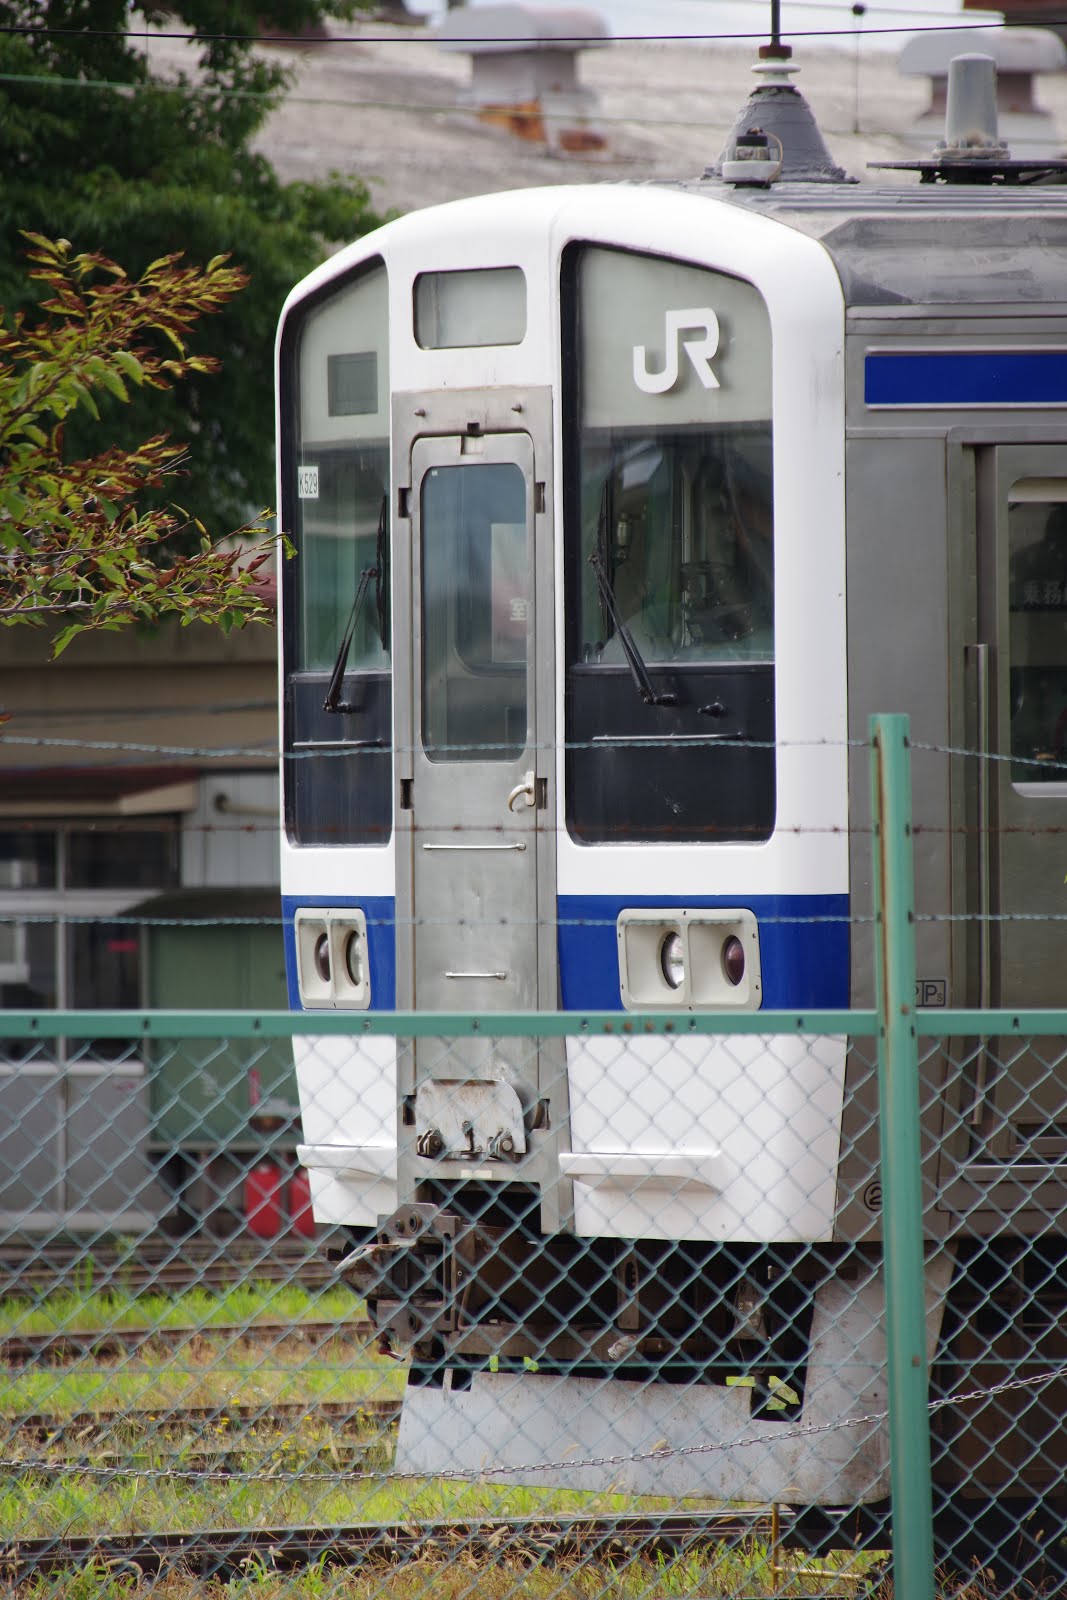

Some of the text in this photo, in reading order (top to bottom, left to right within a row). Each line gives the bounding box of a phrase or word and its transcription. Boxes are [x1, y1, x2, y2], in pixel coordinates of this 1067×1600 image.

[633, 307, 720, 394] JR
[299, 472, 318, 494] K529
[1024, 580, 1067, 605] 乗務
